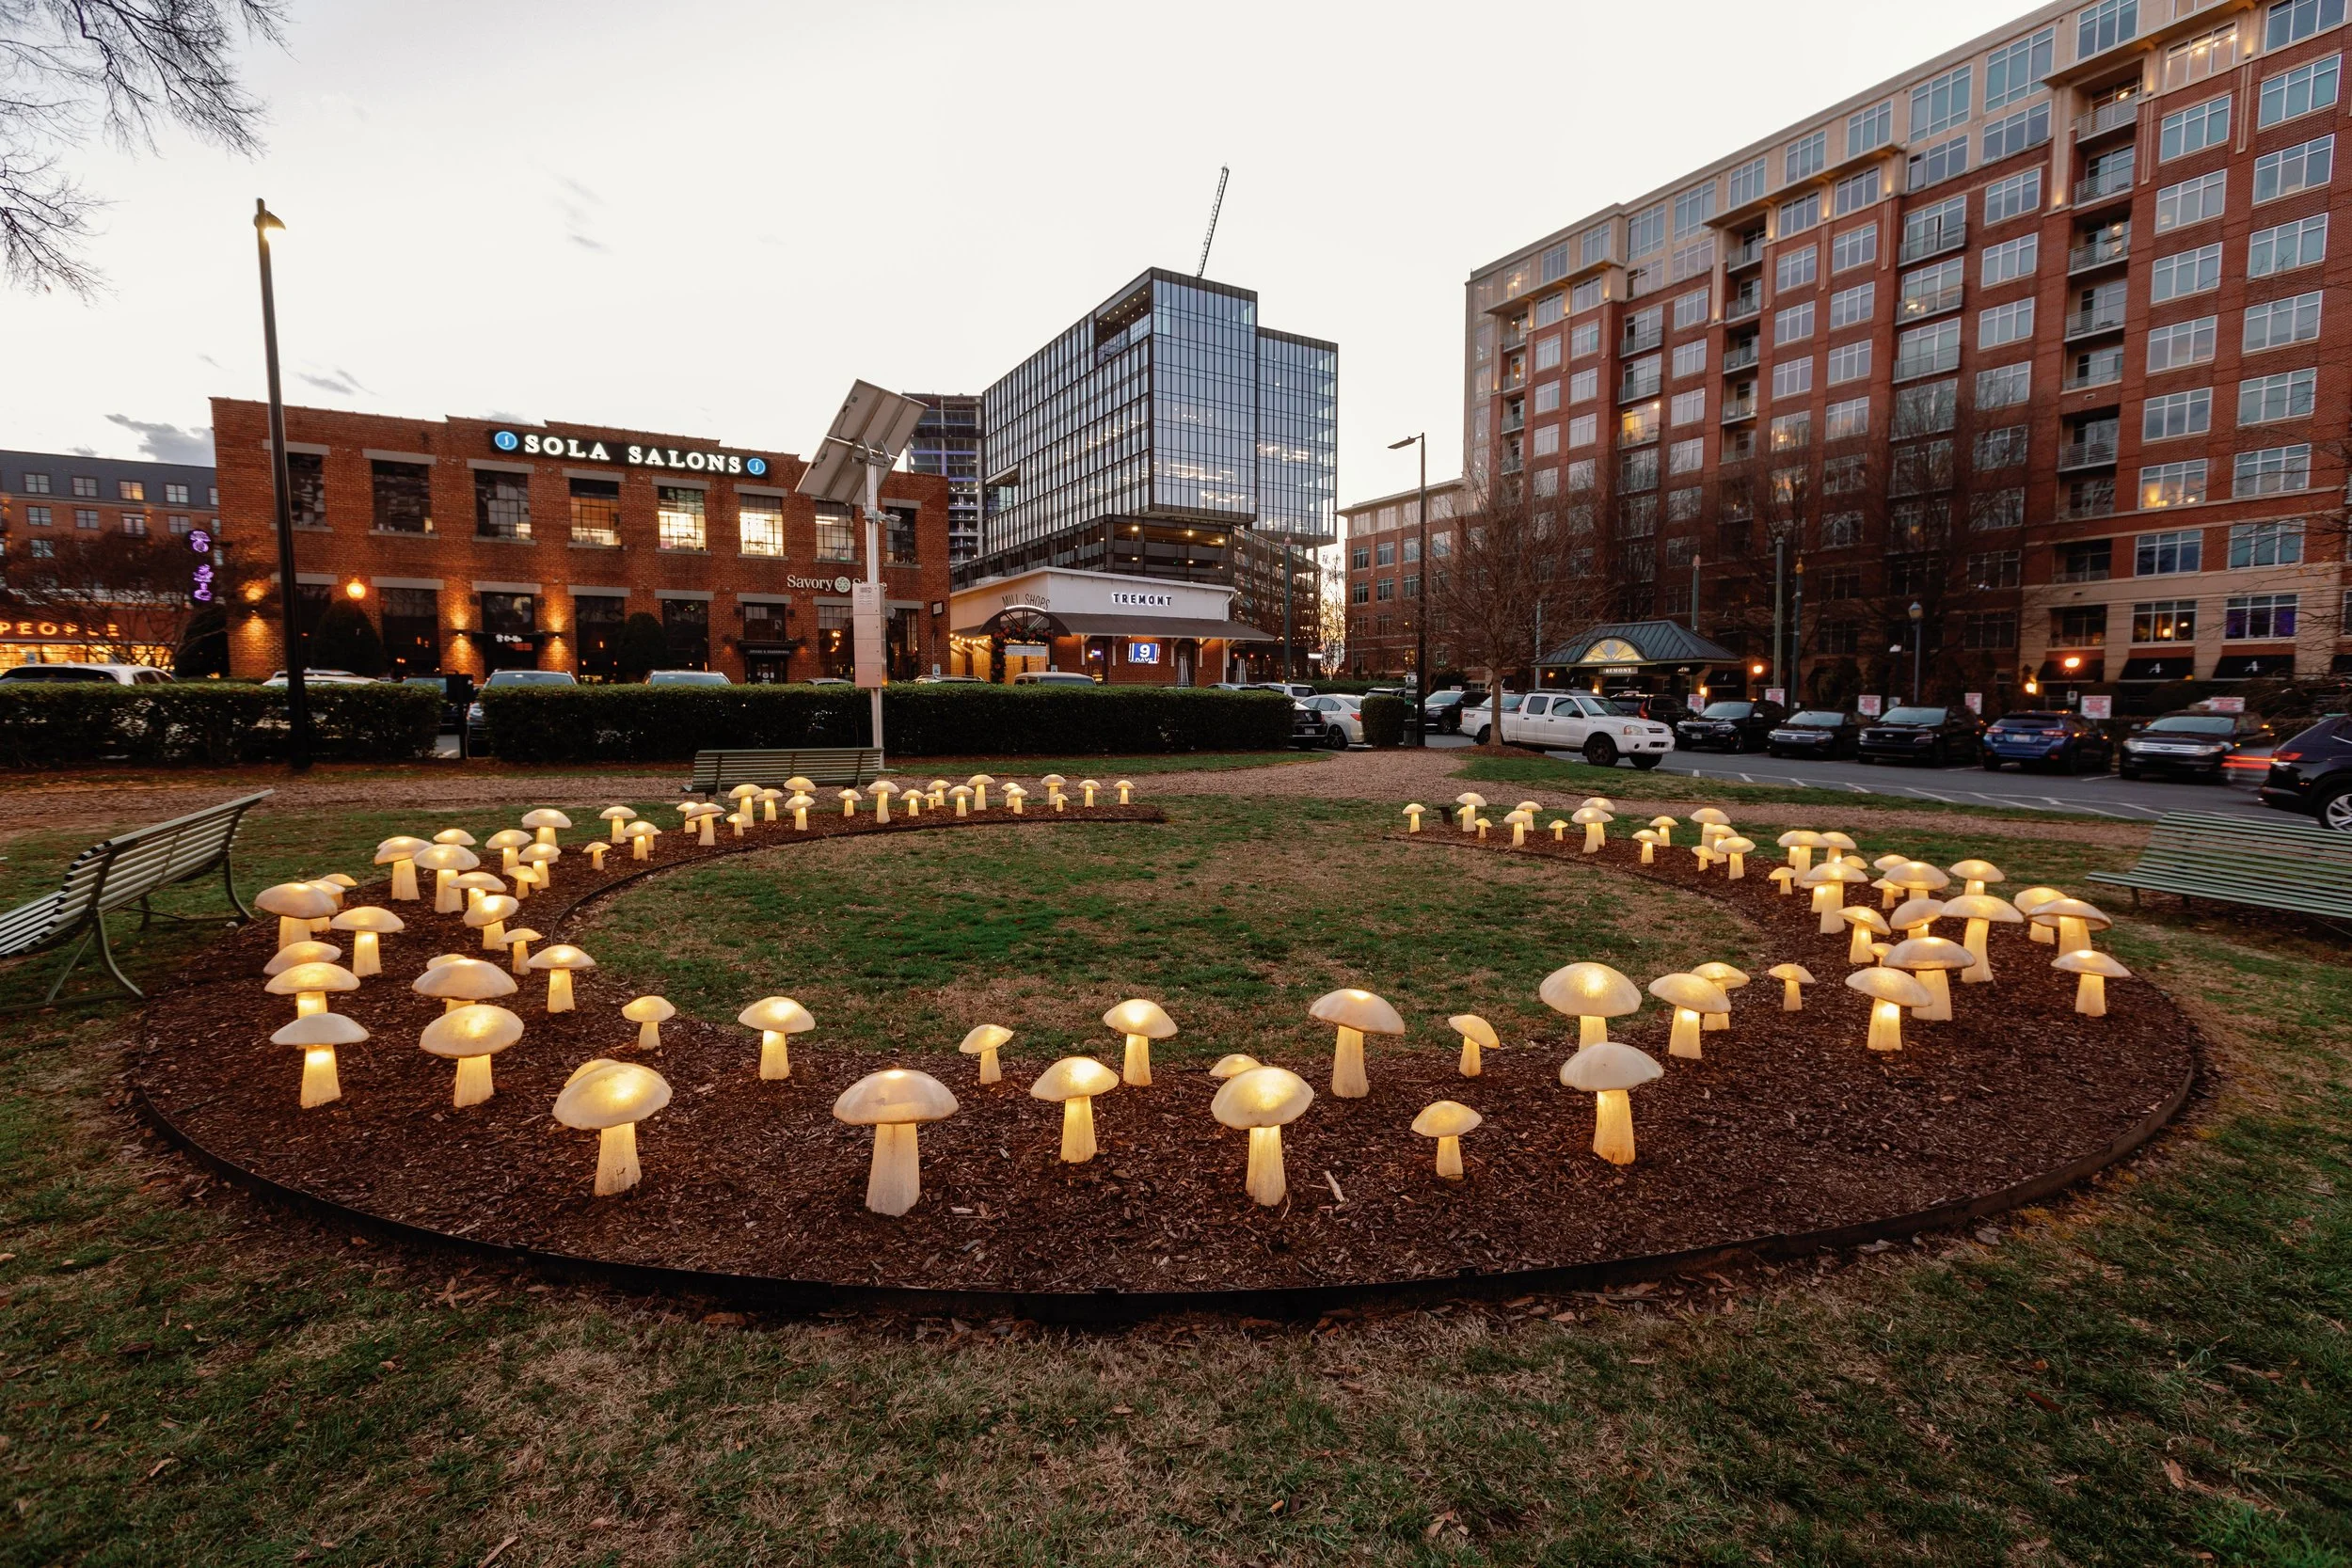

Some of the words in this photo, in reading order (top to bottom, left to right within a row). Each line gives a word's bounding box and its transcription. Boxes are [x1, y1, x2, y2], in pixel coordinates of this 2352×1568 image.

[524, 434, 611, 461] SOLA
[628, 445, 742, 474] SALONS
[787, 575, 834, 592] Savory
[1025, 594, 1051, 610] SHOPS
[1113, 594, 1172, 606] TREMONT
[1139, 644, 1151, 657] 9
